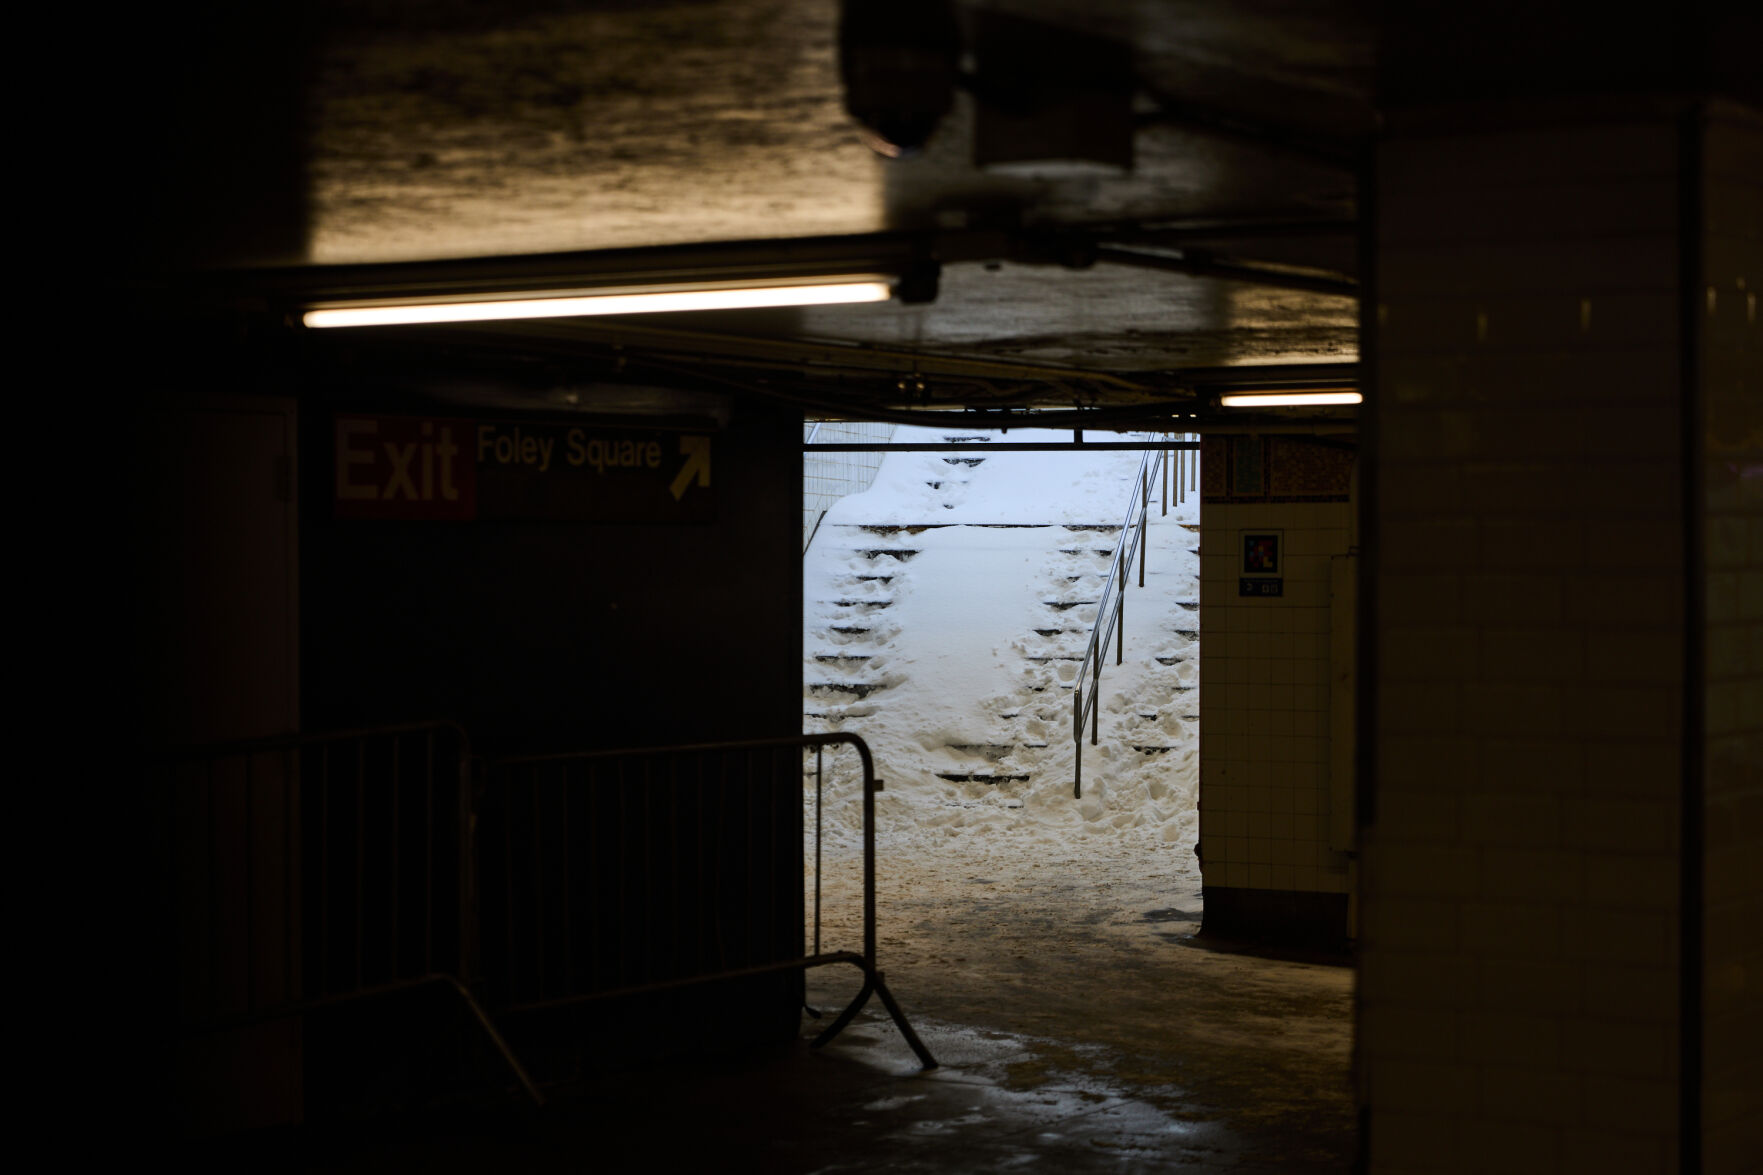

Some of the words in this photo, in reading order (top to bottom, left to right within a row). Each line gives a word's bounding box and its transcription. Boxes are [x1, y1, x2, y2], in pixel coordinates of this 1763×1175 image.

[336, 420, 459, 500] Exit
[477, 425, 554, 472] Foley
[566, 428, 661, 473] Square
